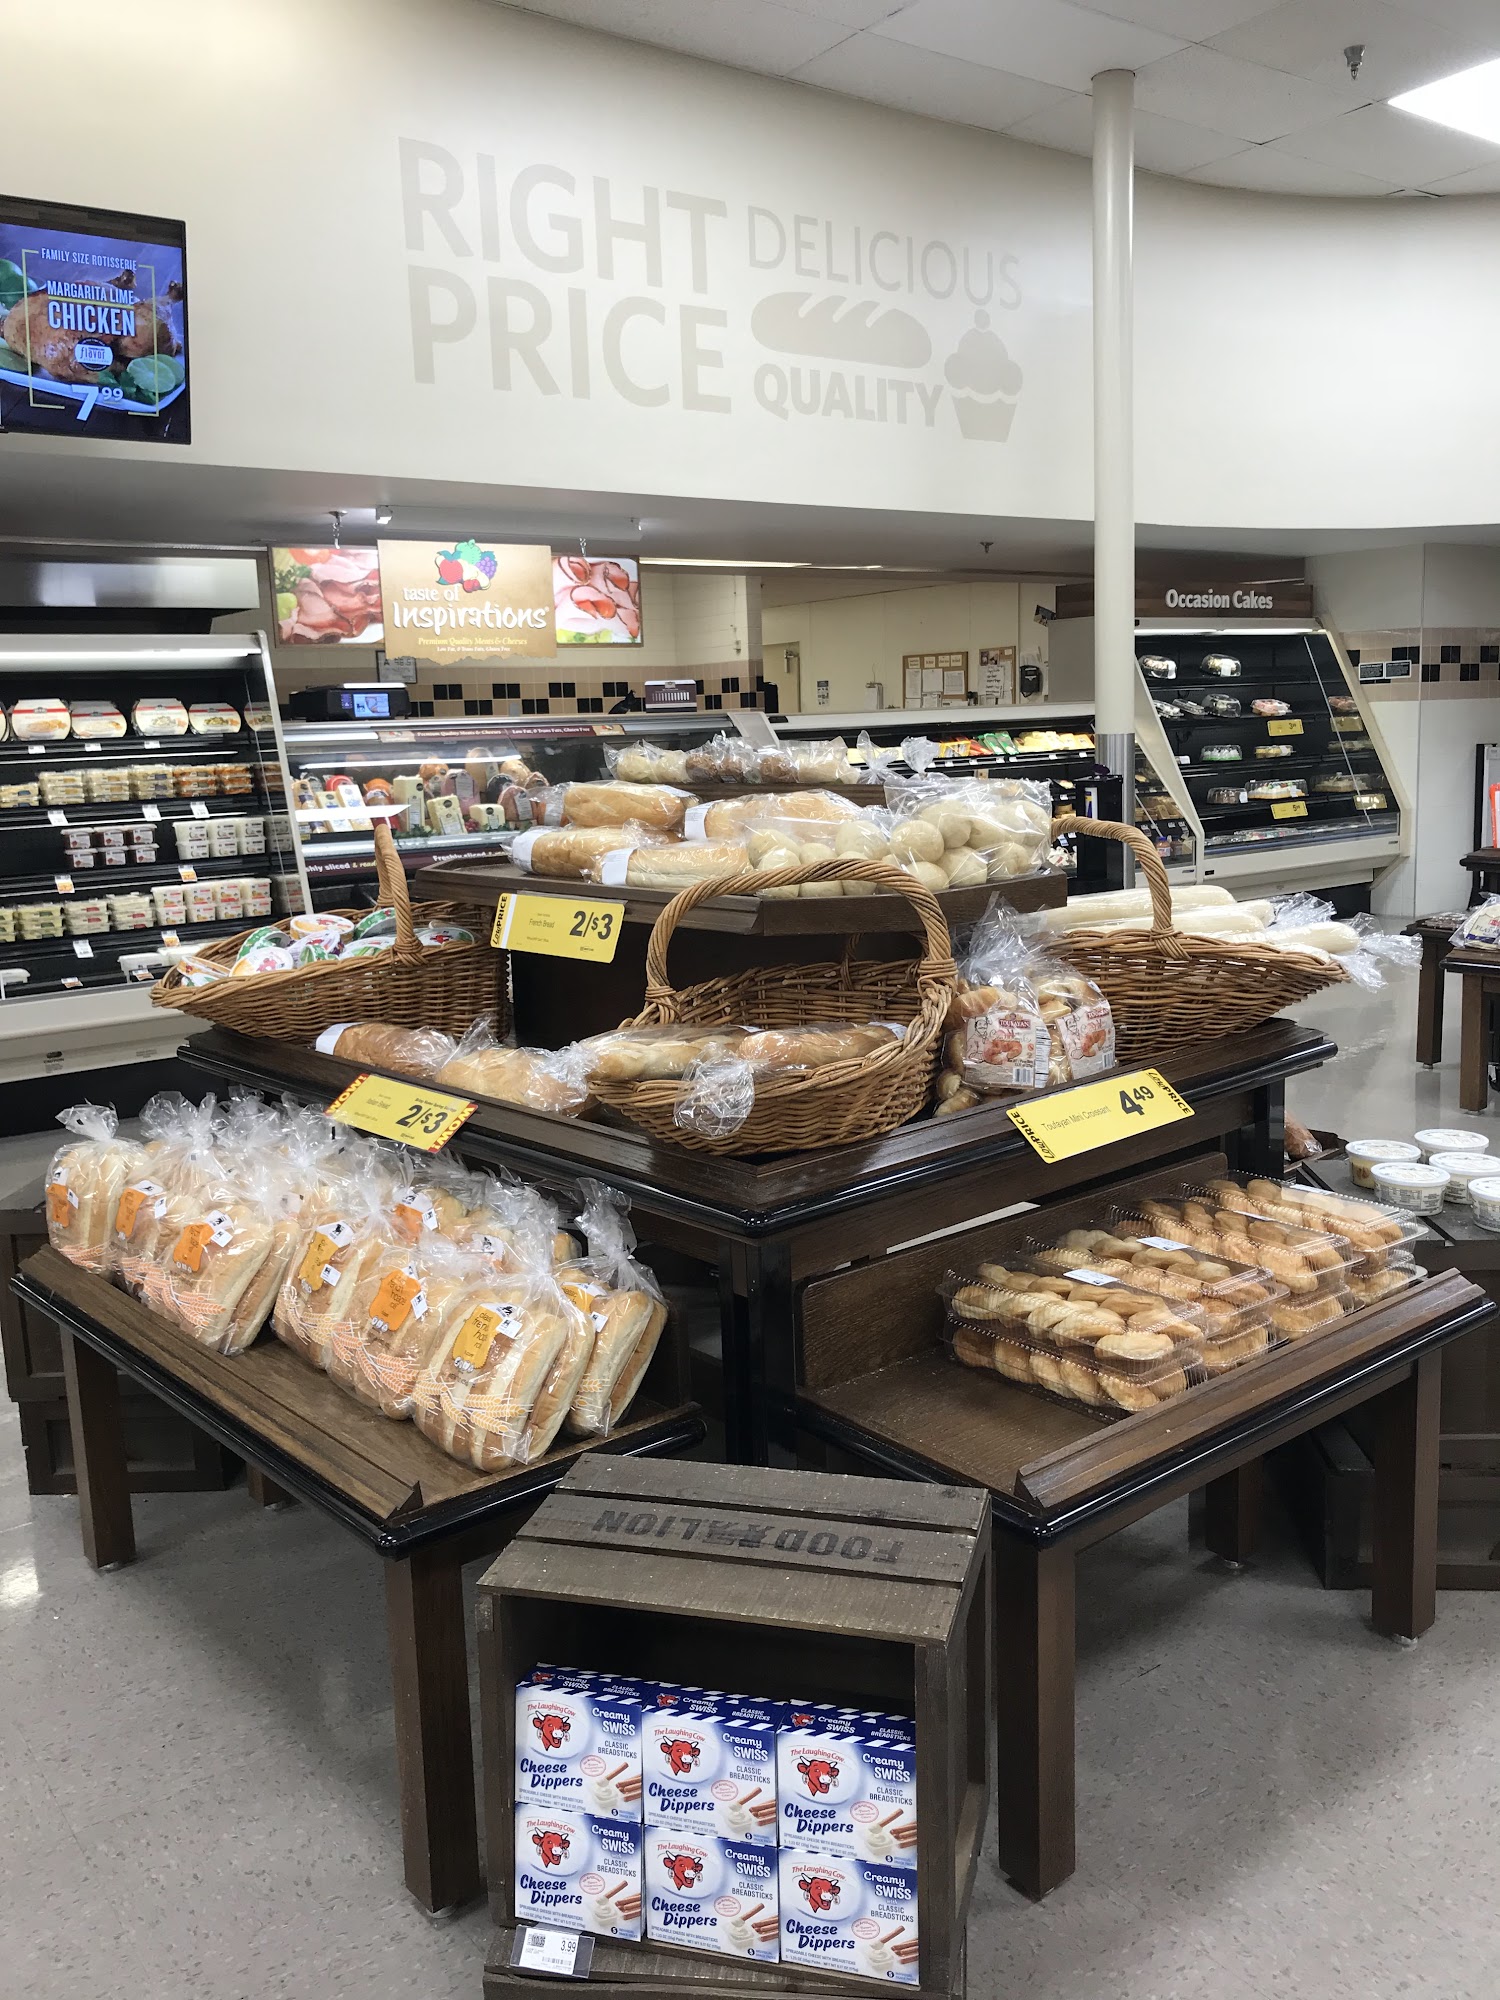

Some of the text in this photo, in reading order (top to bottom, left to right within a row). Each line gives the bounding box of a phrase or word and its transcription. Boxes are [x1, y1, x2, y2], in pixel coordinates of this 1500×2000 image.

[397, 136, 728, 295] RIGHT
[42, 248, 137, 271] FAMILY SIZE ROTISSERIE
[747, 204, 1023, 311] DELICIOUS
[47, 280, 134, 305] MARGARITA LIME
[48, 301, 136, 337] CHICKEN
[407, 264, 732, 414] PRICE
[753, 363, 944, 428] QUALITY
[403, 585, 460, 601] taste of
[1165, 588, 1273, 609] Occasion Cakes
[393, 601, 547, 636] Inspirations
[324, 863, 350, 871] sliced
[359, 860, 377, 868] read
[529, 918, 543, 927] French
[569, 910, 613, 940] 2/$3
[326, 1075, 367, 1114] WOW!
[395, 1104, 448, 1134] 2/$3
[1041, 1105, 1112, 1131] Toufayan Mini Croissant
[432, 1107, 475, 1149] WOW!
[591, 1510, 904, 1564] FOOD LION
[557, 1675, 587, 1684] Creamy
[563, 1680, 590, 1690] SWISS
[537, 1702, 564, 1715] Laughing
[563, 1706, 576, 1718] Cow
[683, 1697, 714, 1707] Creamy
[689, 1704, 718, 1714] SWISS
[592, 1707, 630, 1723] Creamy
[818, 1716, 851, 1726] Creamy
[602, 1720, 636, 1736] SWISS
[664, 1727, 693, 1741] Laughing
[691, 1732, 706, 1743] Cow
[826, 1723, 856, 1734] SWISS
[604, 1740, 629, 1750] CLASSIC
[722, 1732, 762, 1749] Creamy
[597, 1746, 638, 1759] BREADSTICKS
[733, 1746, 768, 1762] SWISS
[802, 1747, 832, 1759] Laughing
[830, 1751, 845, 1763] Cow
[520, 1757, 567, 1774] Cheese
[862, 1753, 905, 1770] Creamy
[729, 1771, 771, 1785] BREADSTICKS
[736, 1765, 762, 1775] CLASSIC
[874, 1766, 911, 1783] SWISS
[531, 1773, 583, 1790] Dippers
[648, 1782, 698, 1798] Cheese
[876, 1786, 903, 1797] CLASSIC
[660, 1799, 715, 1814] Dippers
[869, 1792, 913, 1806] BREADSTICKS
[784, 1803, 836, 1819] Cheese
[526, 1819, 576, 1834] The Laughing Cow
[592, 1825, 629, 1840] Creamy
[796, 1819, 854, 1835] Dippers
[602, 1838, 635, 1854] SWISS
[667, 1842, 696, 1855] Laughing
[694, 1847, 709, 1858] Cow
[603, 1858, 628, 1868] CLASSIC
[725, 1848, 765, 1865] Creamy
[597, 1865, 637, 1878] BREADSTICKS
[736, 1863, 771, 1878] SWISS
[792, 1865, 846, 1880] The Laughing Cow
[520, 1874, 567, 1891] Cheese
[738, 1881, 764, 1892] CLASSIC
[863, 1871, 906, 1887] Creamy
[531, 1890, 582, 1906] Dippers
[731, 1887, 774, 1901] BREADSTICKS
[875, 1884, 912, 1900] SWISS
[651, 1896, 701, 1913] Cheese
[878, 1904, 905, 1914] CLASSIC
[663, 1912, 717, 1929] Dippers
[870, 1910, 914, 1923] BREADSTICKS
[786, 1918, 838, 1935] Cheese
[561, 1940, 576, 1953] 3.99
[798, 1934, 856, 1951] Dippers
